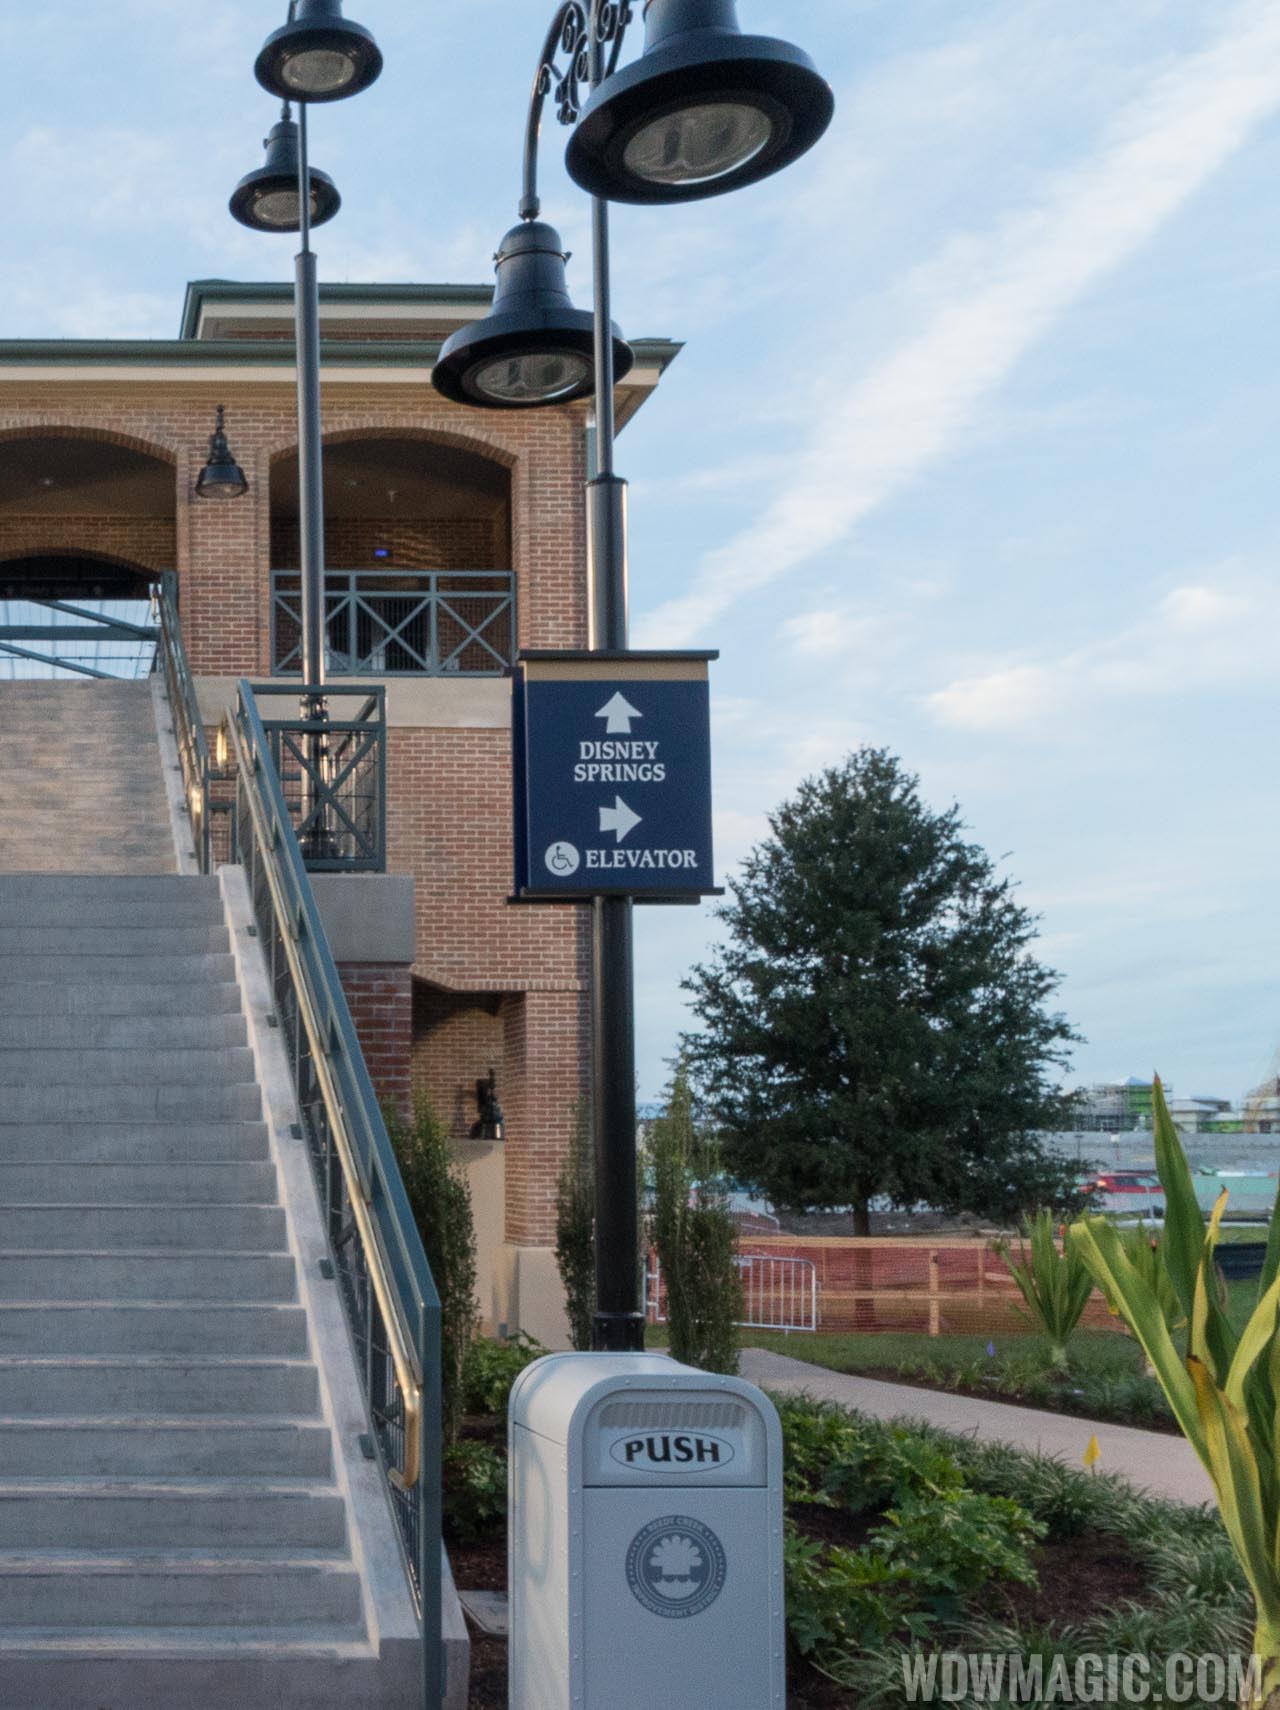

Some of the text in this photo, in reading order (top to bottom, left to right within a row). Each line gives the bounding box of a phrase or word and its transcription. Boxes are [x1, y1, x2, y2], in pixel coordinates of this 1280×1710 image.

[579, 741, 659, 760] DISNEY
[574, 763, 666, 782] SPRINGS
[586, 849, 698, 868] ELEVATOR
[625, 1436, 720, 1463] PUSH
